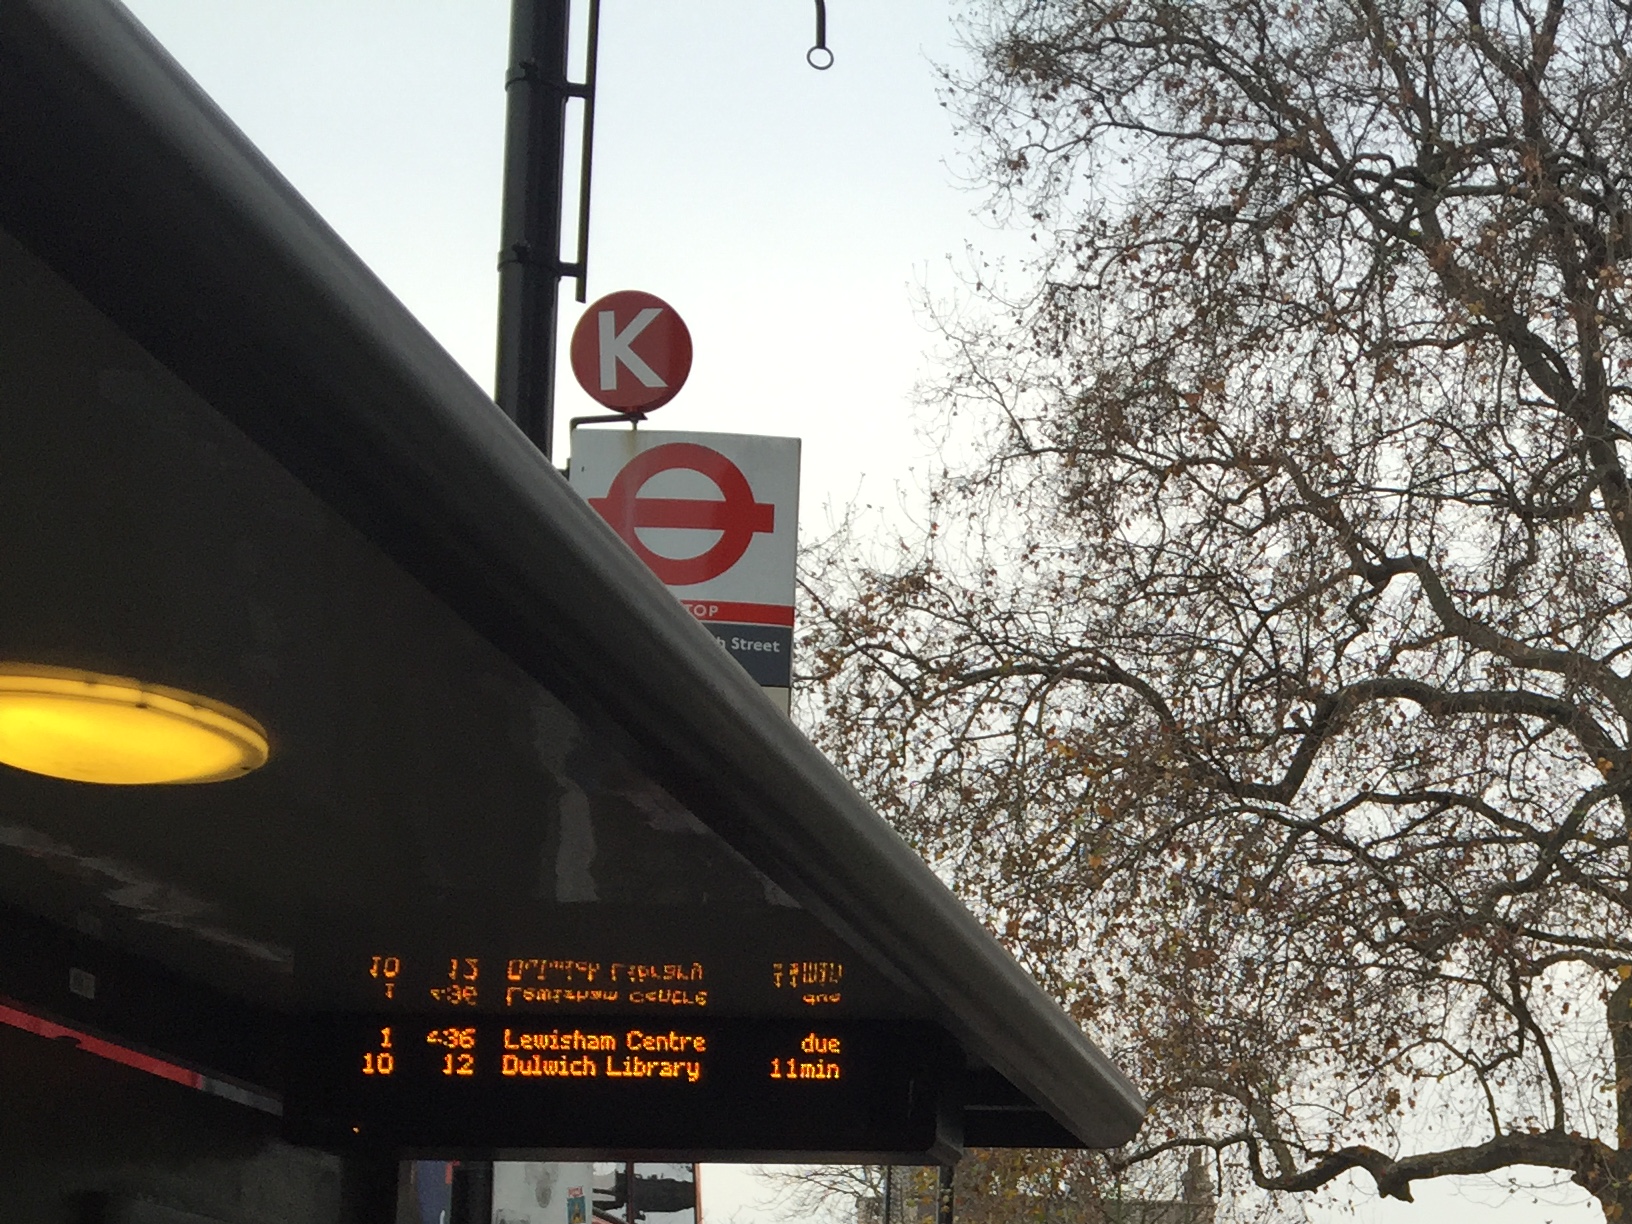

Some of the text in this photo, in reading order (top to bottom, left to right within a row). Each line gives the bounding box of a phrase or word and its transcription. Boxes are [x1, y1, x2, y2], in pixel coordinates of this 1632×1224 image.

[598, 307, 668, 391] K
[731, 637, 780, 653] Street
[381, 1027, 392, 1049] 1
[504, 1029, 616, 1050] Lewisham
[626, 1031, 706, 1052] Centre
[801, 1033, 841, 1054] due
[362, 1053, 394, 1075] 10
[442, 1053, 474, 1075] 12
[502, 1054, 597, 1077] Dulwich
[606, 1056, 700, 1082] Library
